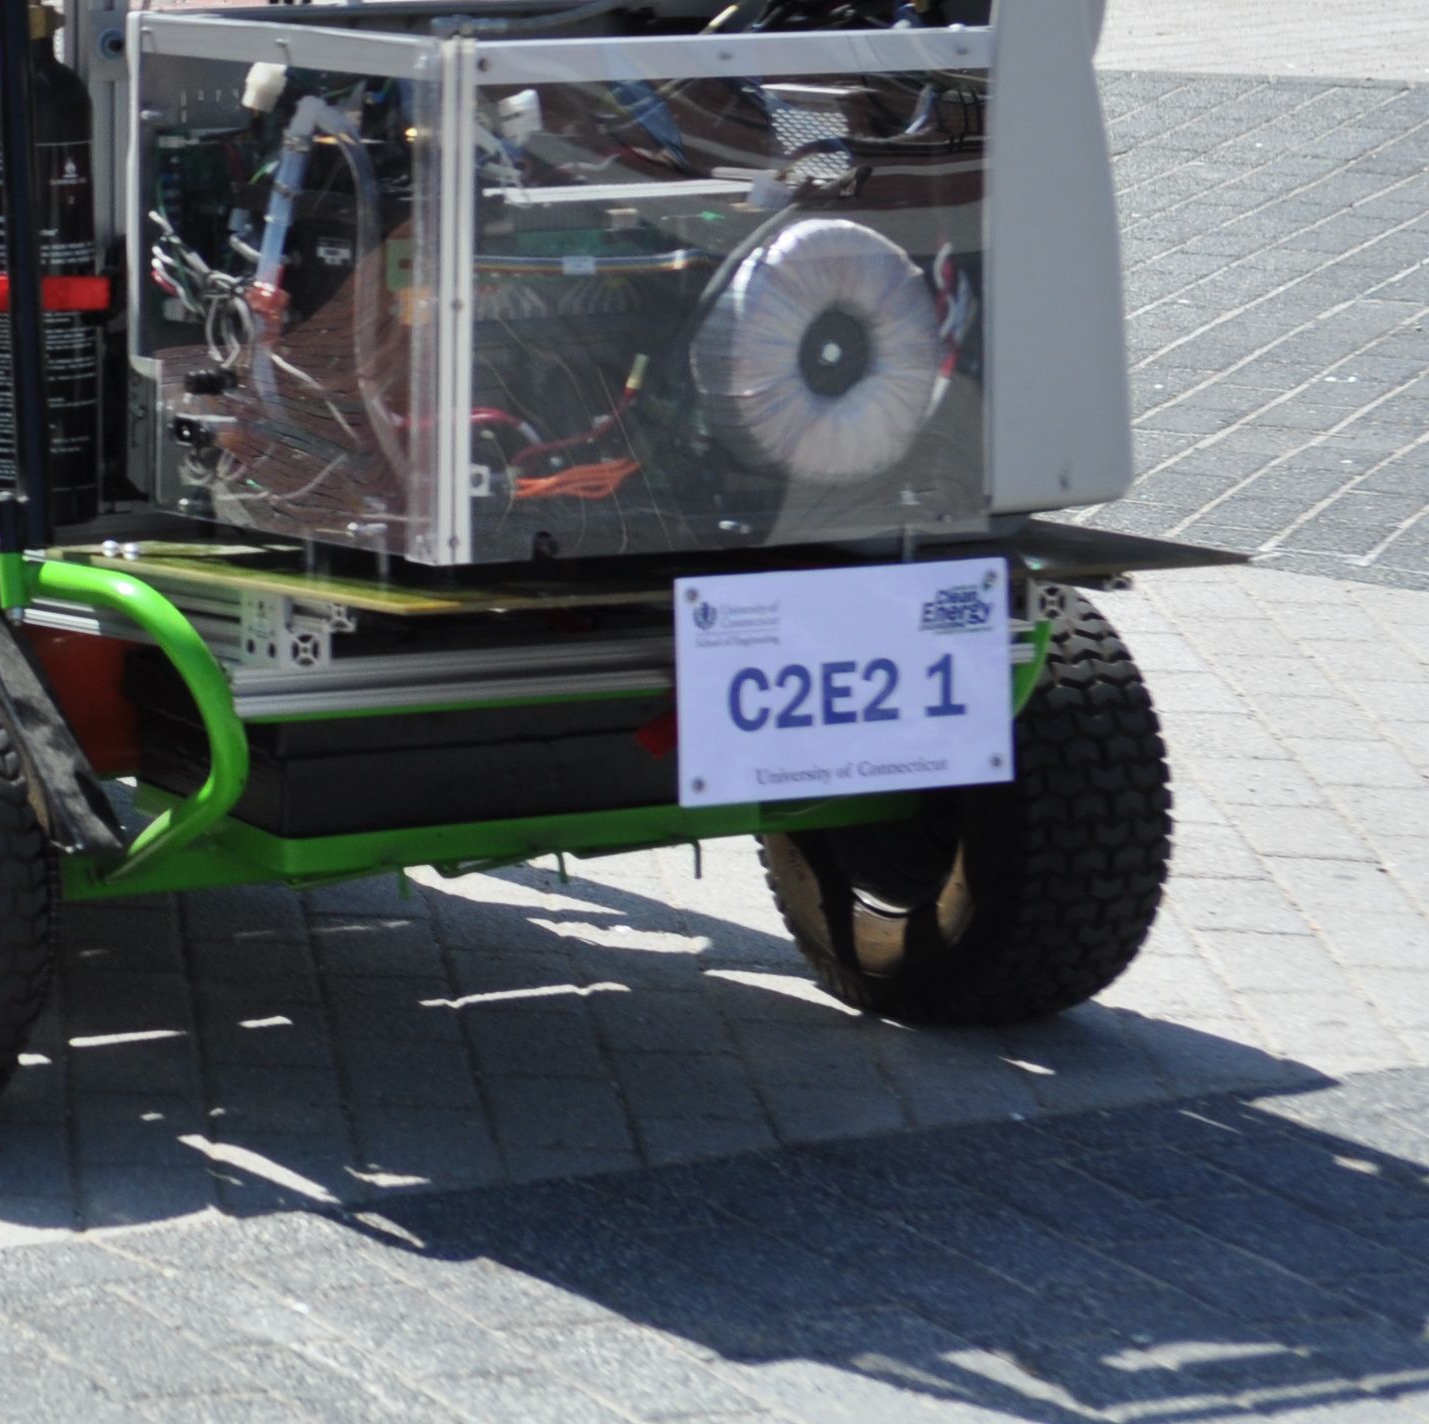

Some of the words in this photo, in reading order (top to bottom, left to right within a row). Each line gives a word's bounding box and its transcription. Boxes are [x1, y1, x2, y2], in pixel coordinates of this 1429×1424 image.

[935, 589, 978, 605] Clean
[920, 600, 994, 625] Energy
[727, 657, 901, 733] C2E2
[924, 652, 967, 718] 1
[755, 763, 832, 787] University
[836, 760, 855, 779] of
[857, 755, 950, 779] Connecticut
